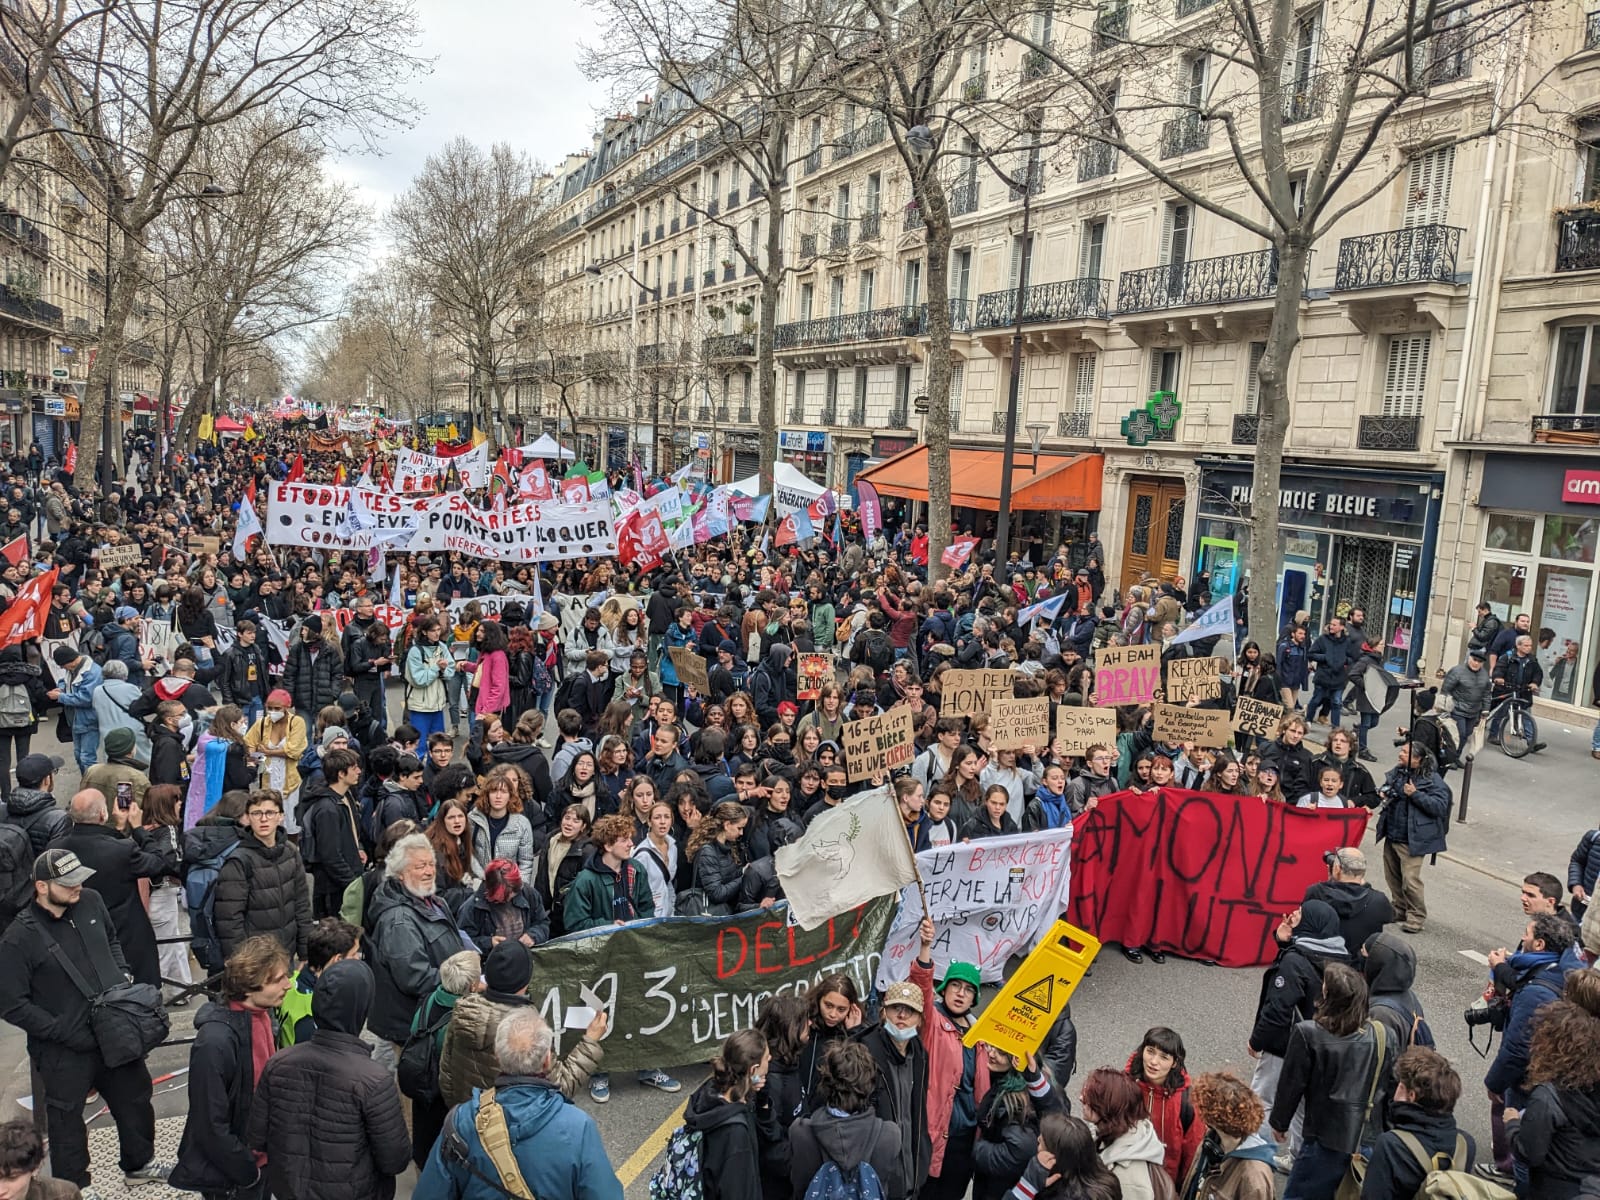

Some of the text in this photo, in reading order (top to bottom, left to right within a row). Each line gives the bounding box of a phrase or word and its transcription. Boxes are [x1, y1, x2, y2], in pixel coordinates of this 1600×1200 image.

[277, 484, 401, 513] ÉTUDIAT.E.S
[1231, 485, 1376, 516] PHACIE BLEUE
[1511, 565, 1527, 578] 71
[1103, 649, 1154, 667] AH BAH
[983, 673, 997, 687] DE
[1004, 674, 1016, 687] LA
[993, 719, 1007, 729] LES
[1239, 711, 1274, 727] POUR LES
[847, 717, 884, 739] 16-64
[995, 730, 1009, 740] MA
[1074, 727, 1096, 737] PARA
[1239, 721, 1268, 737] CRS
[848, 741, 870, 756] UNE
[848, 759, 863, 775] PAS
[867, 753, 887, 772] UNE
[932, 840, 1065, 876] LA BARRICADE
[922, 878, 985, 905] FERME
[994, 881, 1012, 904] LA
[1147, 878, 1291, 966] LUTT
[1021, 1004, 1034, 1014] SOL
